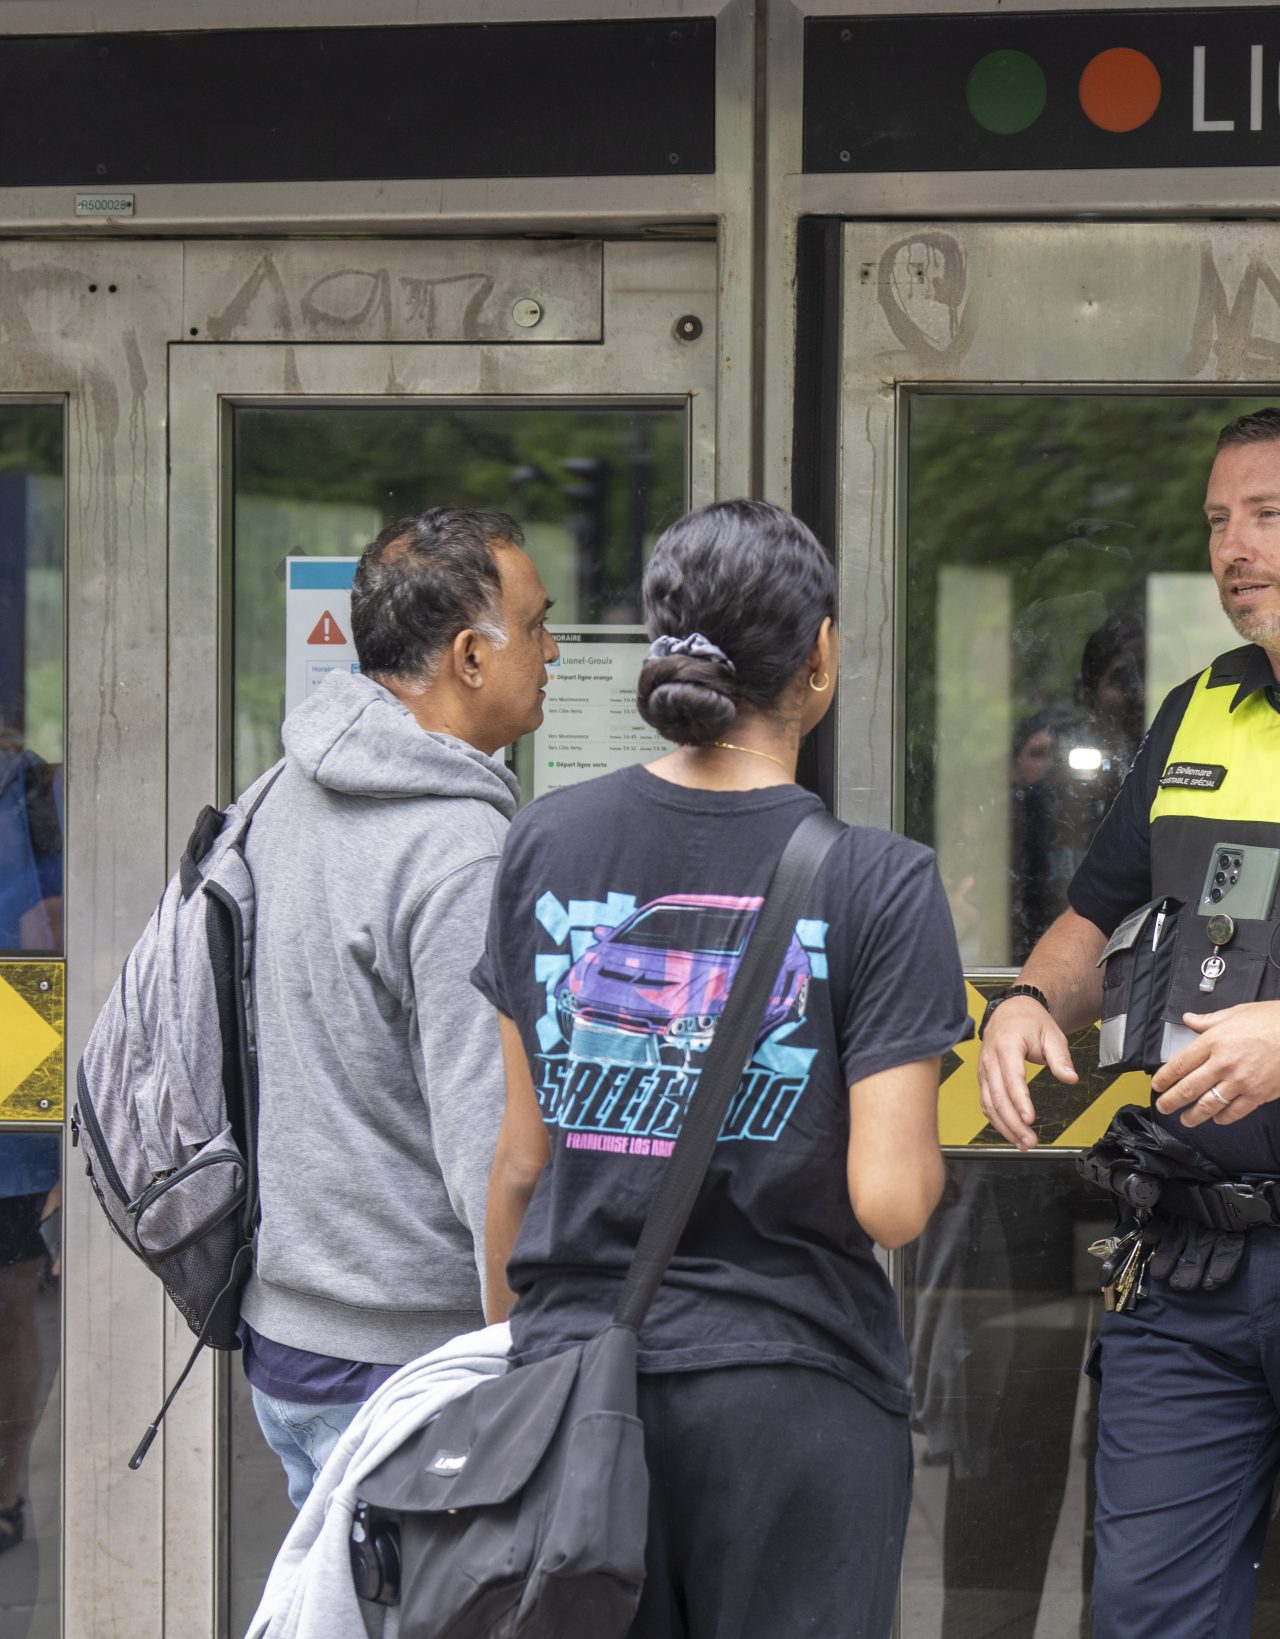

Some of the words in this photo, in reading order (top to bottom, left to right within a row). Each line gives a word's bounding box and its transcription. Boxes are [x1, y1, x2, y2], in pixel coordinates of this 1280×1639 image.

[562, 657, 613, 665] Lionel-Groulx
[1190, 777, 1215, 787] SPÉCIAL
[566, 1132, 629, 1153] FRANCHISE
[629, 1137, 651, 1155] LOS
